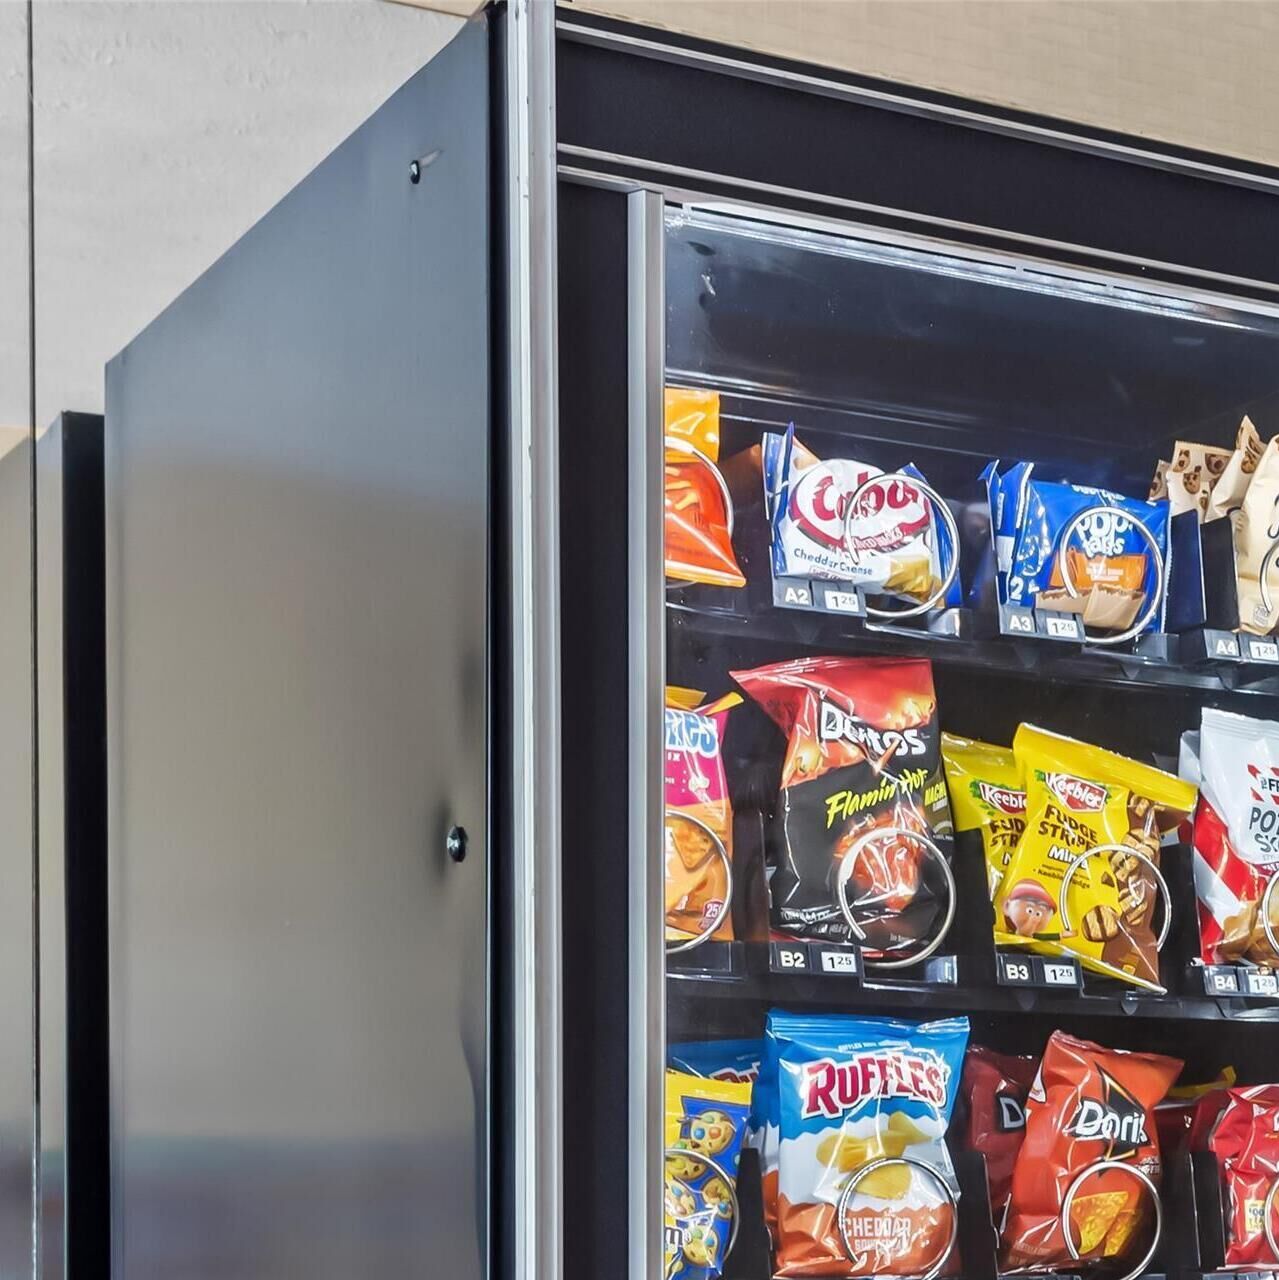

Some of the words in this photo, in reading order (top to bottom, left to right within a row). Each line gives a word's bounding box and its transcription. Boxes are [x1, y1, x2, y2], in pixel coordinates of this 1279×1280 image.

[785, 587, 809, 605] A2
[1009, 615, 1032, 632] A3
[1216, 639, 1236, 655] A4
[1046, 772, 1107, 812] Keebler
[780, 951, 806, 968] B2
[1006, 963, 1029, 980] B3
[1213, 976, 1237, 991] B4
